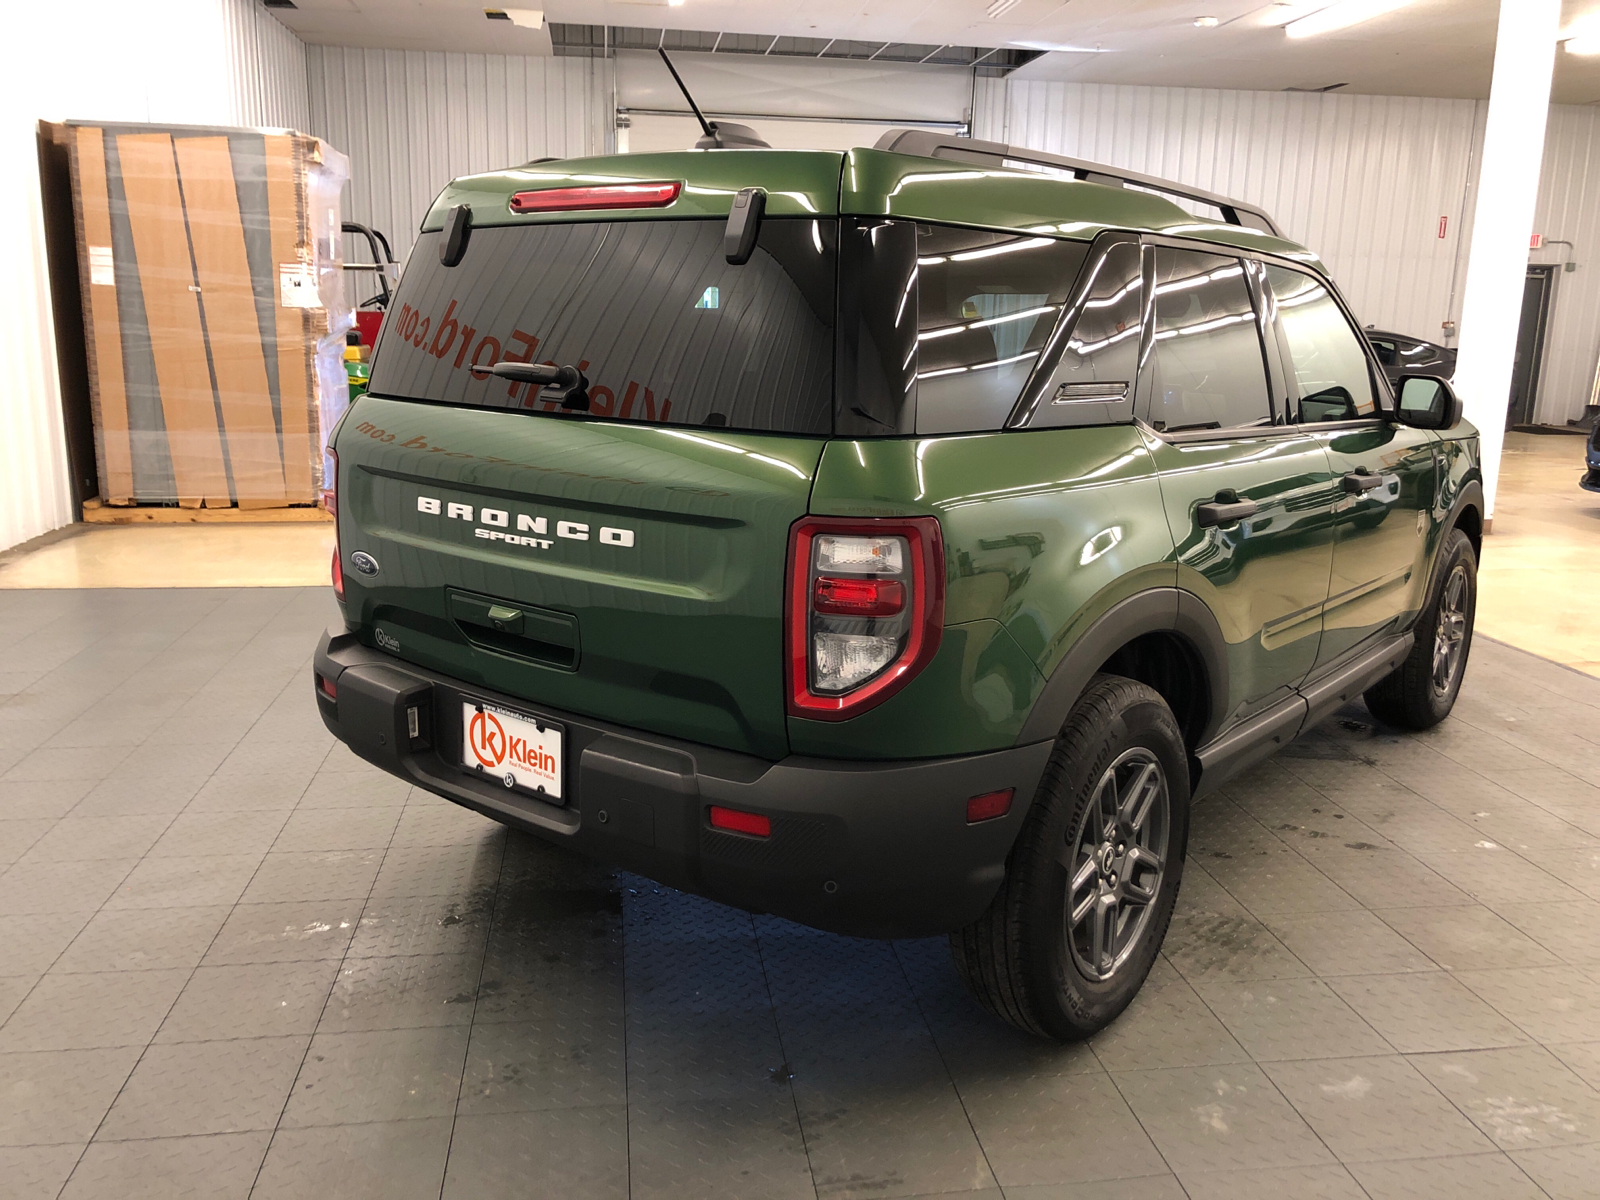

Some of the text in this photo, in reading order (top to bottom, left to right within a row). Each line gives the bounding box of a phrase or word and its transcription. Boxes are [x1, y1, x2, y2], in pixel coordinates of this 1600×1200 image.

[417, 496, 635, 547] BRONCO
[474, 528, 554, 550] SPORT
[482, 703, 537, 725] www.kleinauto.com
[509, 735, 556, 774] Klein
[508, 760, 518, 768] Real
[533, 768, 543, 777] Real
